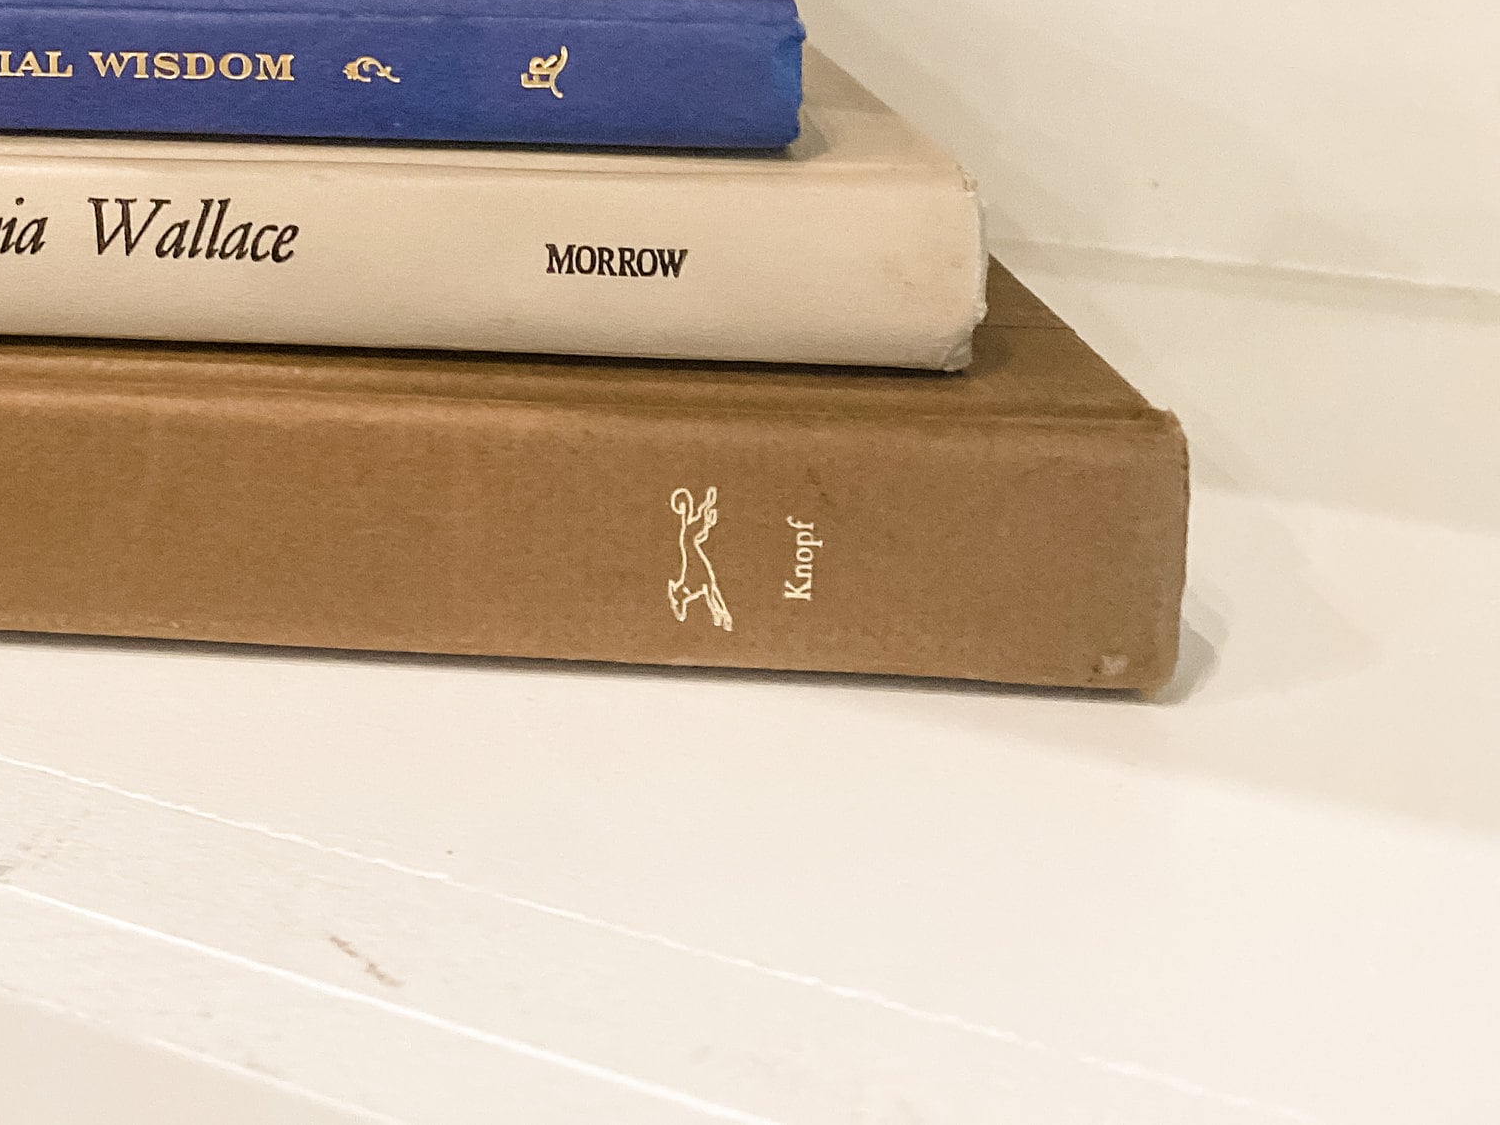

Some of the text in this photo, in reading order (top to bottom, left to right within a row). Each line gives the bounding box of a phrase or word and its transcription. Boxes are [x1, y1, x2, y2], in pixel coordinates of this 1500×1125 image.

[89, 52, 294, 80] WISDOM
[88, 198, 299, 263] Wallace
[546, 244, 688, 278] MORROW
[784, 516, 823, 600] Knopf
